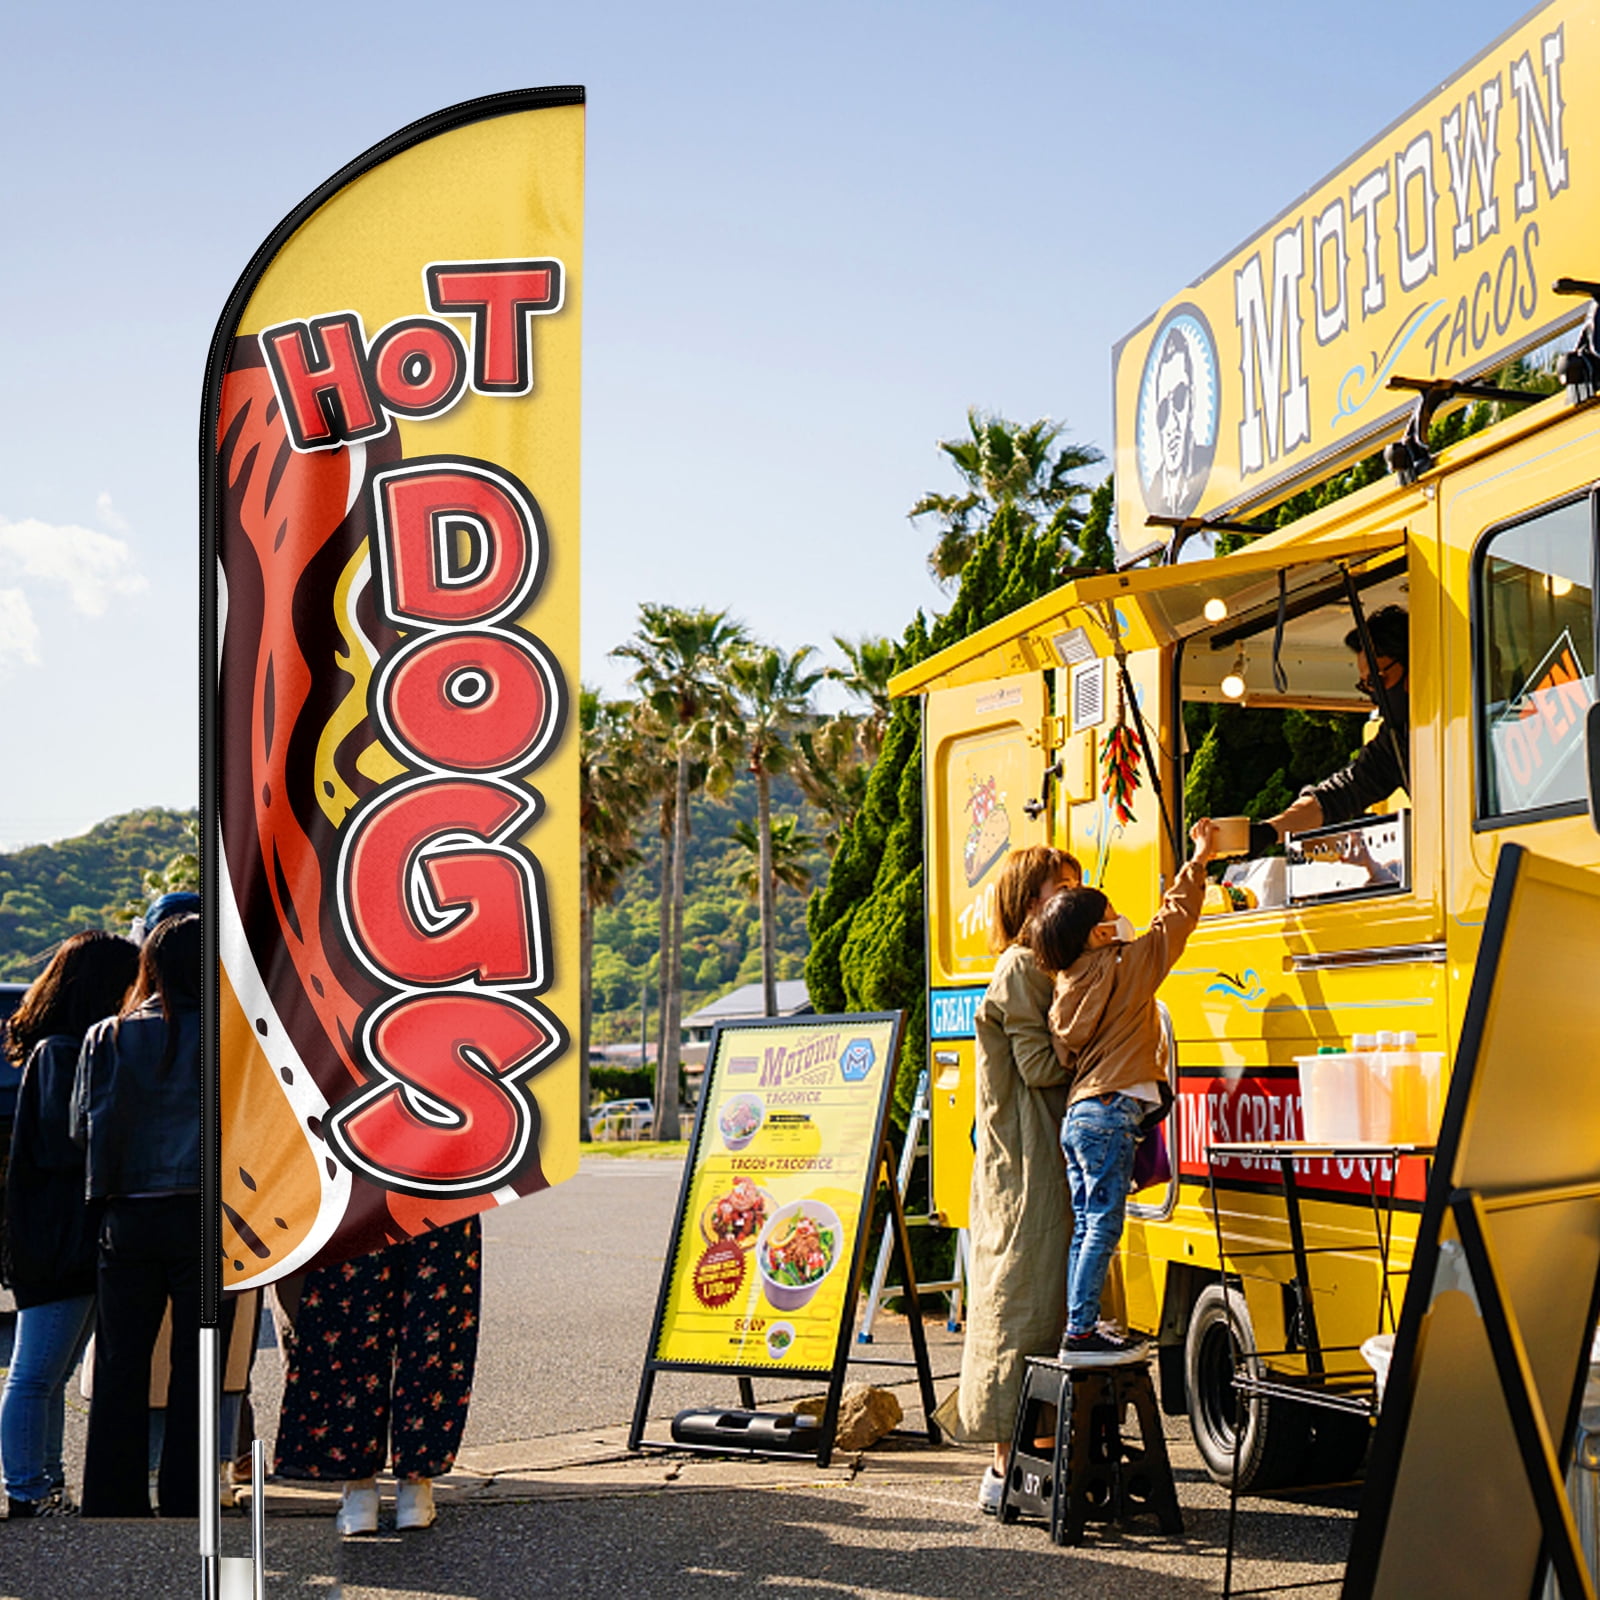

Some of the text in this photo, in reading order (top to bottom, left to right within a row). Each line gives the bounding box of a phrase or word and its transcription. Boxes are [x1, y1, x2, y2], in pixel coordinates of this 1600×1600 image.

[1234, 21, 1569, 481] MOTOWN
[1424, 221, 1541, 375] TACOS
[257, 257, 566, 454] HOT
[1504, 648, 1588, 787] OPEN
[327, 456, 567, 1193] DOGS
[932, 996, 971, 1034] GREAT
[730, 1158, 834, 1170] TACOS TACORICE
[766, 1091, 823, 1105] TACORICE
[1176, 1092, 1231, 1168] IMES
